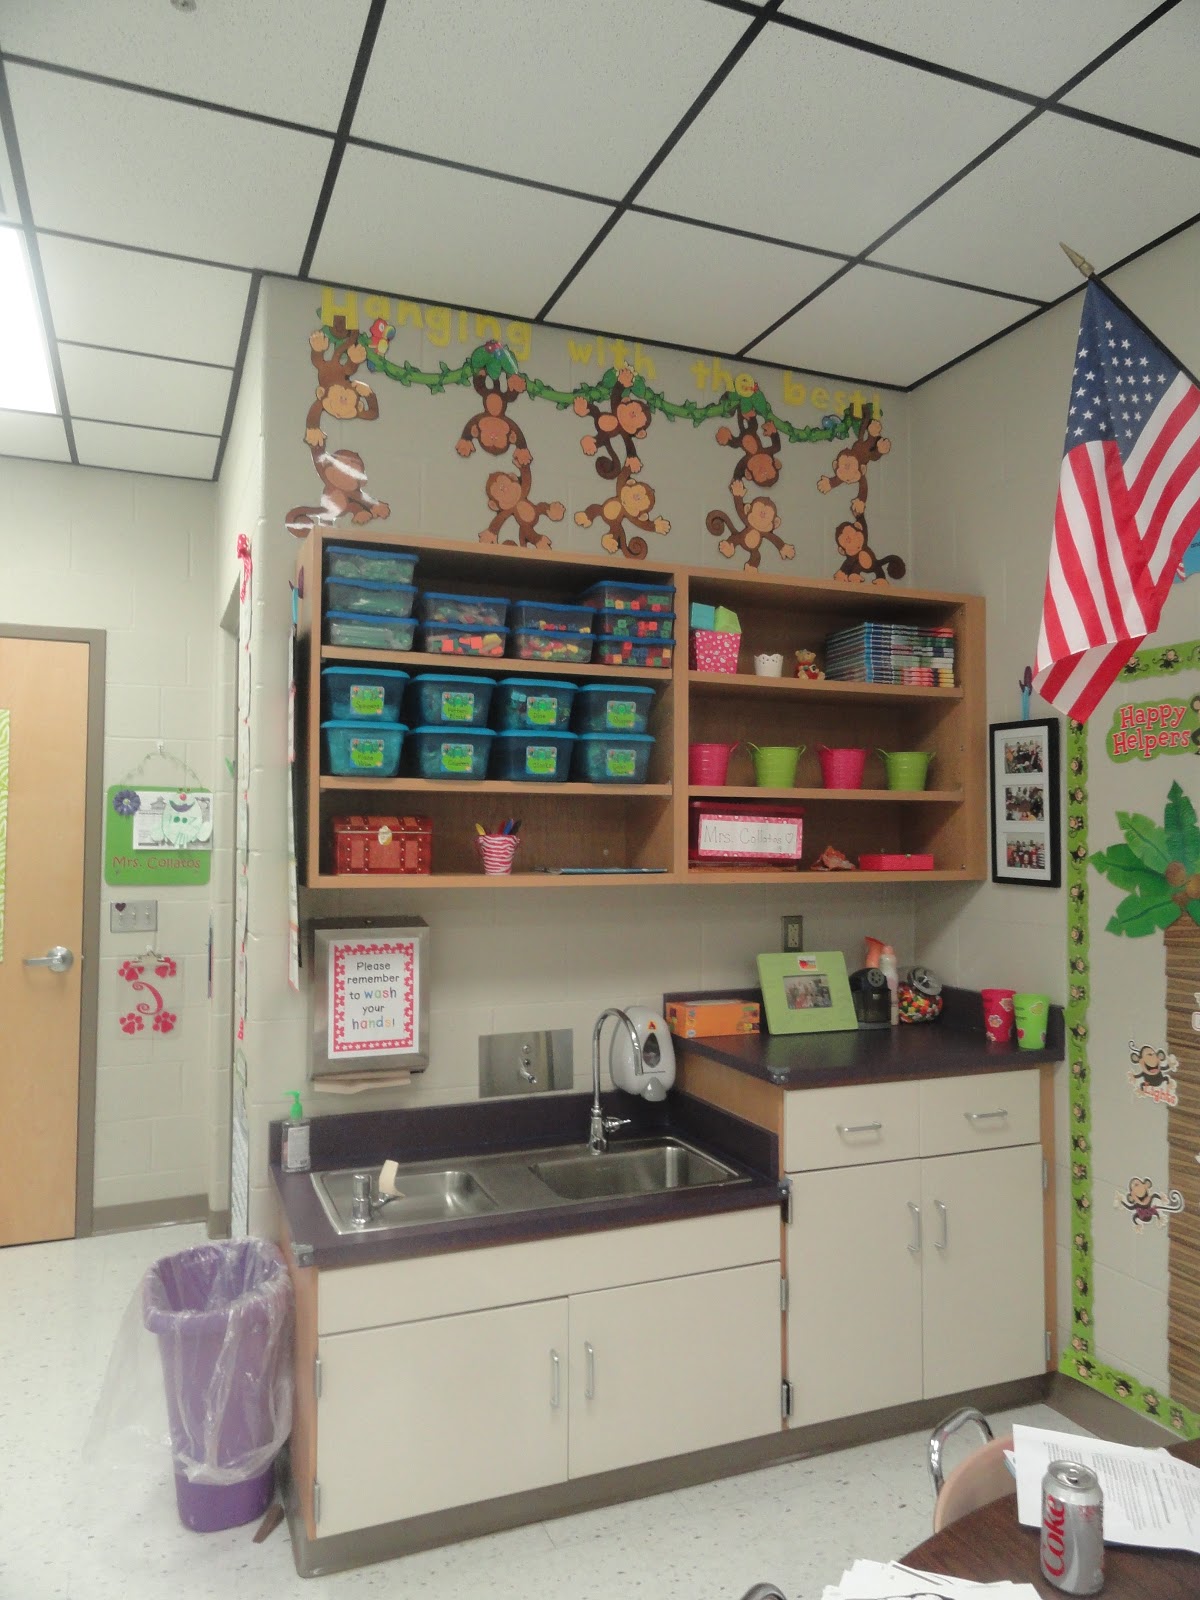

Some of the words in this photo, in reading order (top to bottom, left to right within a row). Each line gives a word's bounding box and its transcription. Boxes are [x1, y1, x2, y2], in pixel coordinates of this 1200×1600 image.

[321, 286, 532, 362] Hanging
[567, 335, 657, 380] with
[690, 357, 755, 398] the
[1120, 704, 1187, 730] Happy
[1112, 727, 1191, 758] Helpers
[703, 825, 734, 844] Mrs.
[112, 855, 142, 869] Mrs.
[356, 961, 391, 971] Please
[347, 974, 400, 985] remember
[349, 991, 361, 1000] to
[364, 987, 397, 999] wash
[362, 1005, 385, 1016] your
[352, 1016, 395, 1030] hands!
[1043, 1494, 1066, 1578] Coke
